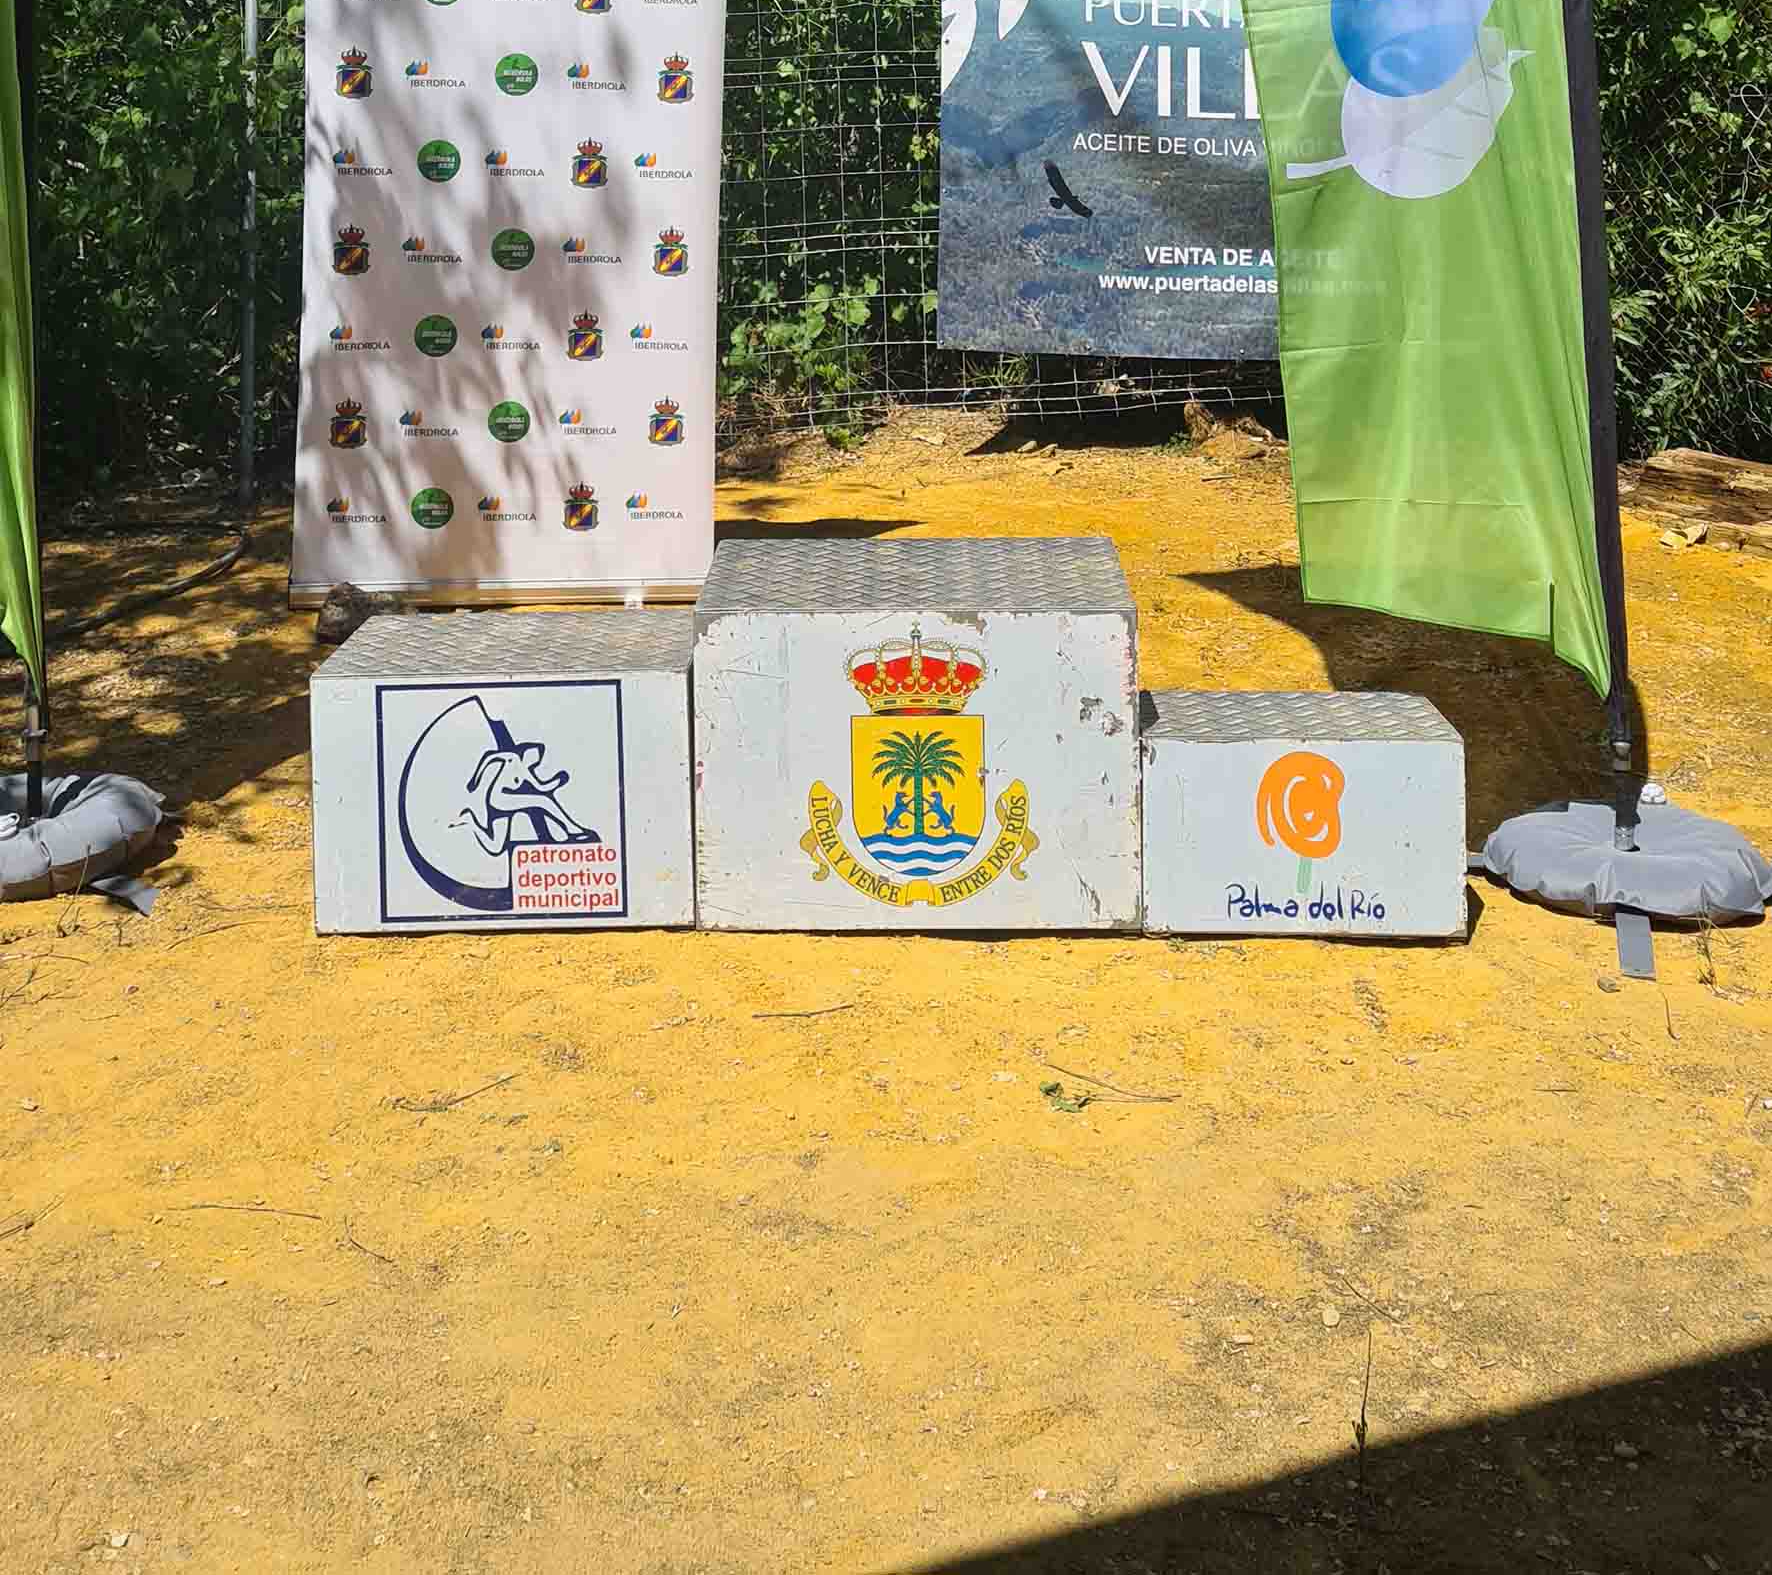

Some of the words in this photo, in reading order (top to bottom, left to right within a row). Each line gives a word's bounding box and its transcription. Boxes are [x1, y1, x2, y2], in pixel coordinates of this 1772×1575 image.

[1072, 133, 1151, 153] ACEITE
[1157, 136, 1187, 155] DE
[1193, 138, 1258, 157] OLIVA
[1144, 245, 1217, 266] VENTA
[1223, 248, 1254, 266] DE
[1099, 275, 1279, 295] www.puertadelas
[517, 845, 618, 867] patronato
[810, 795, 838, 852] LUCHA
[831, 847, 849, 866] Y
[848, 864, 900, 903] VENCE
[939, 863, 993, 903] ENTRE
[988, 835, 1017, 868] DOS
[517, 869, 618, 891] deportivo
[517, 888, 619, 910] municipal
[1225, 883, 1299, 919] Palma
[1308, 881, 1344, 921] del
[1351, 889, 1386, 920] Río
